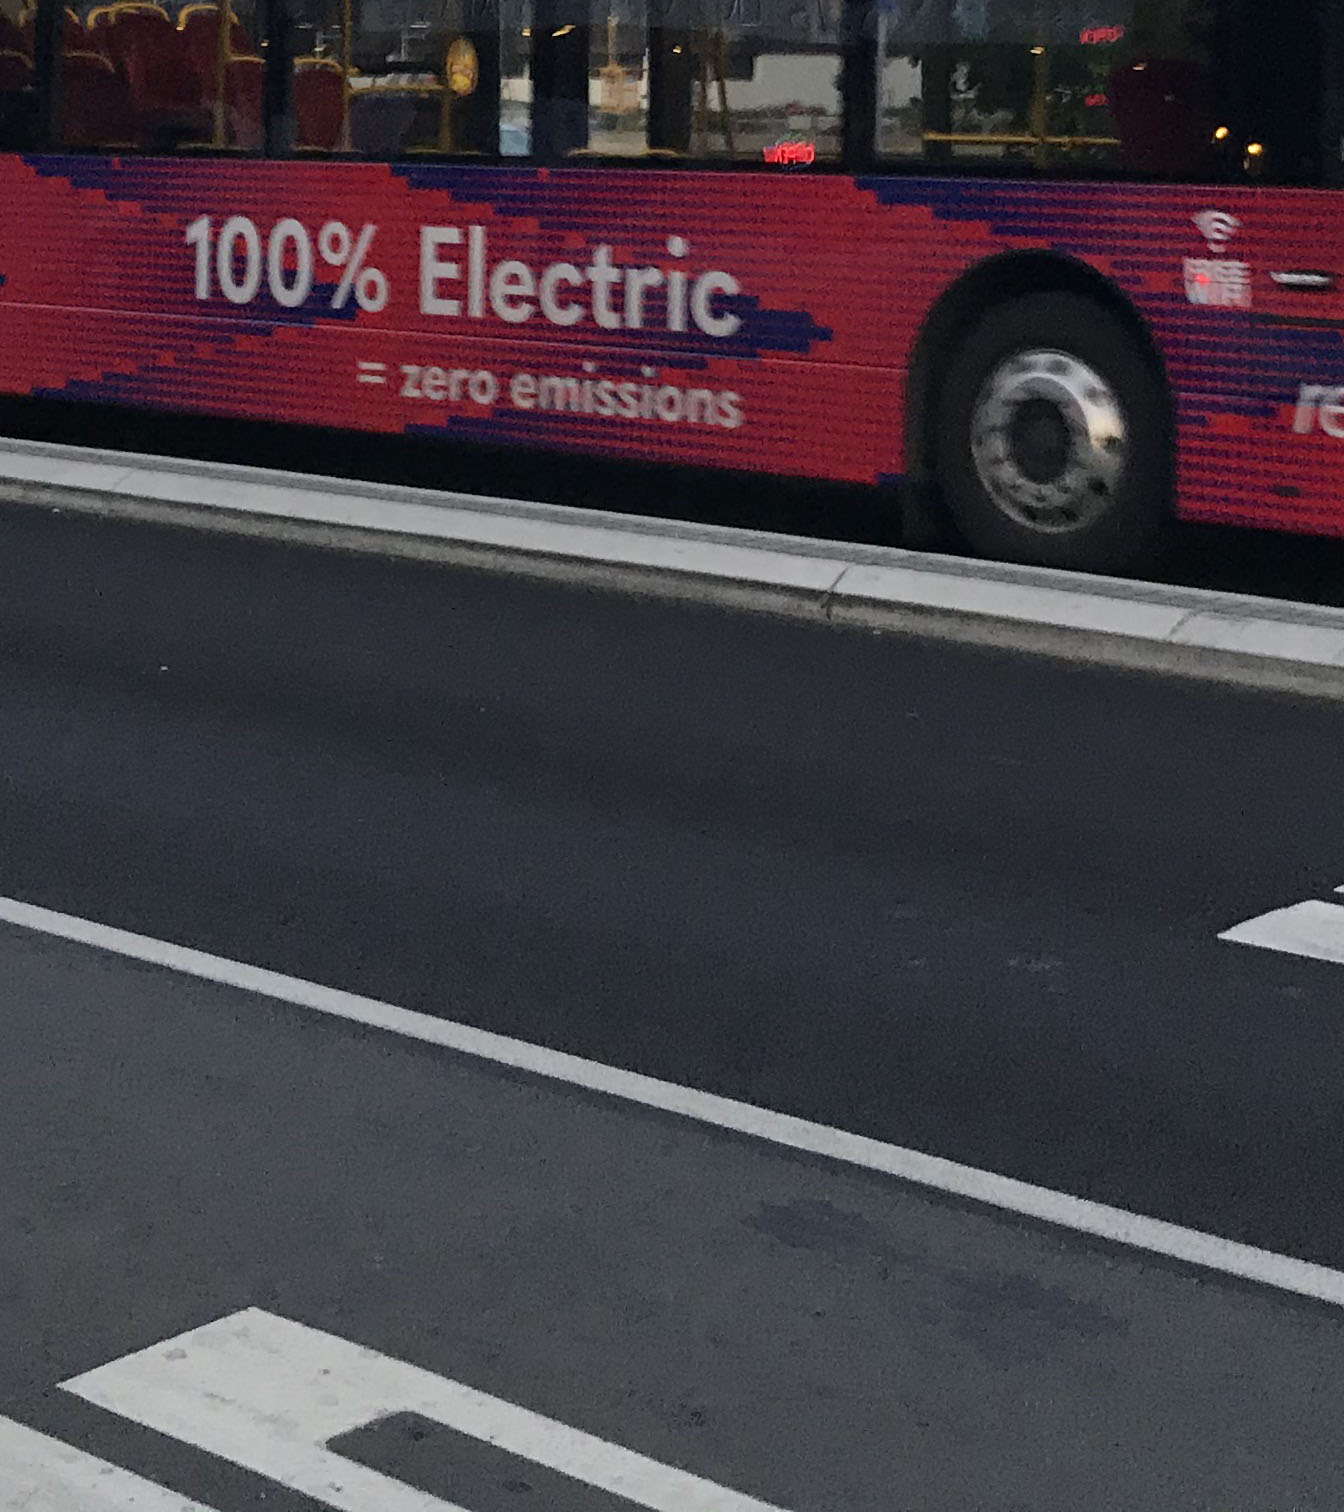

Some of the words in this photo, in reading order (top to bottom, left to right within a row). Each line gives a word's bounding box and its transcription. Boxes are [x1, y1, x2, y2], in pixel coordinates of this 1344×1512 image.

[185, 214, 389, 314] 100%
[418, 225, 744, 338] Electric
[399, 362, 498, 405] zero
[510, 362, 744, 429] emissions
